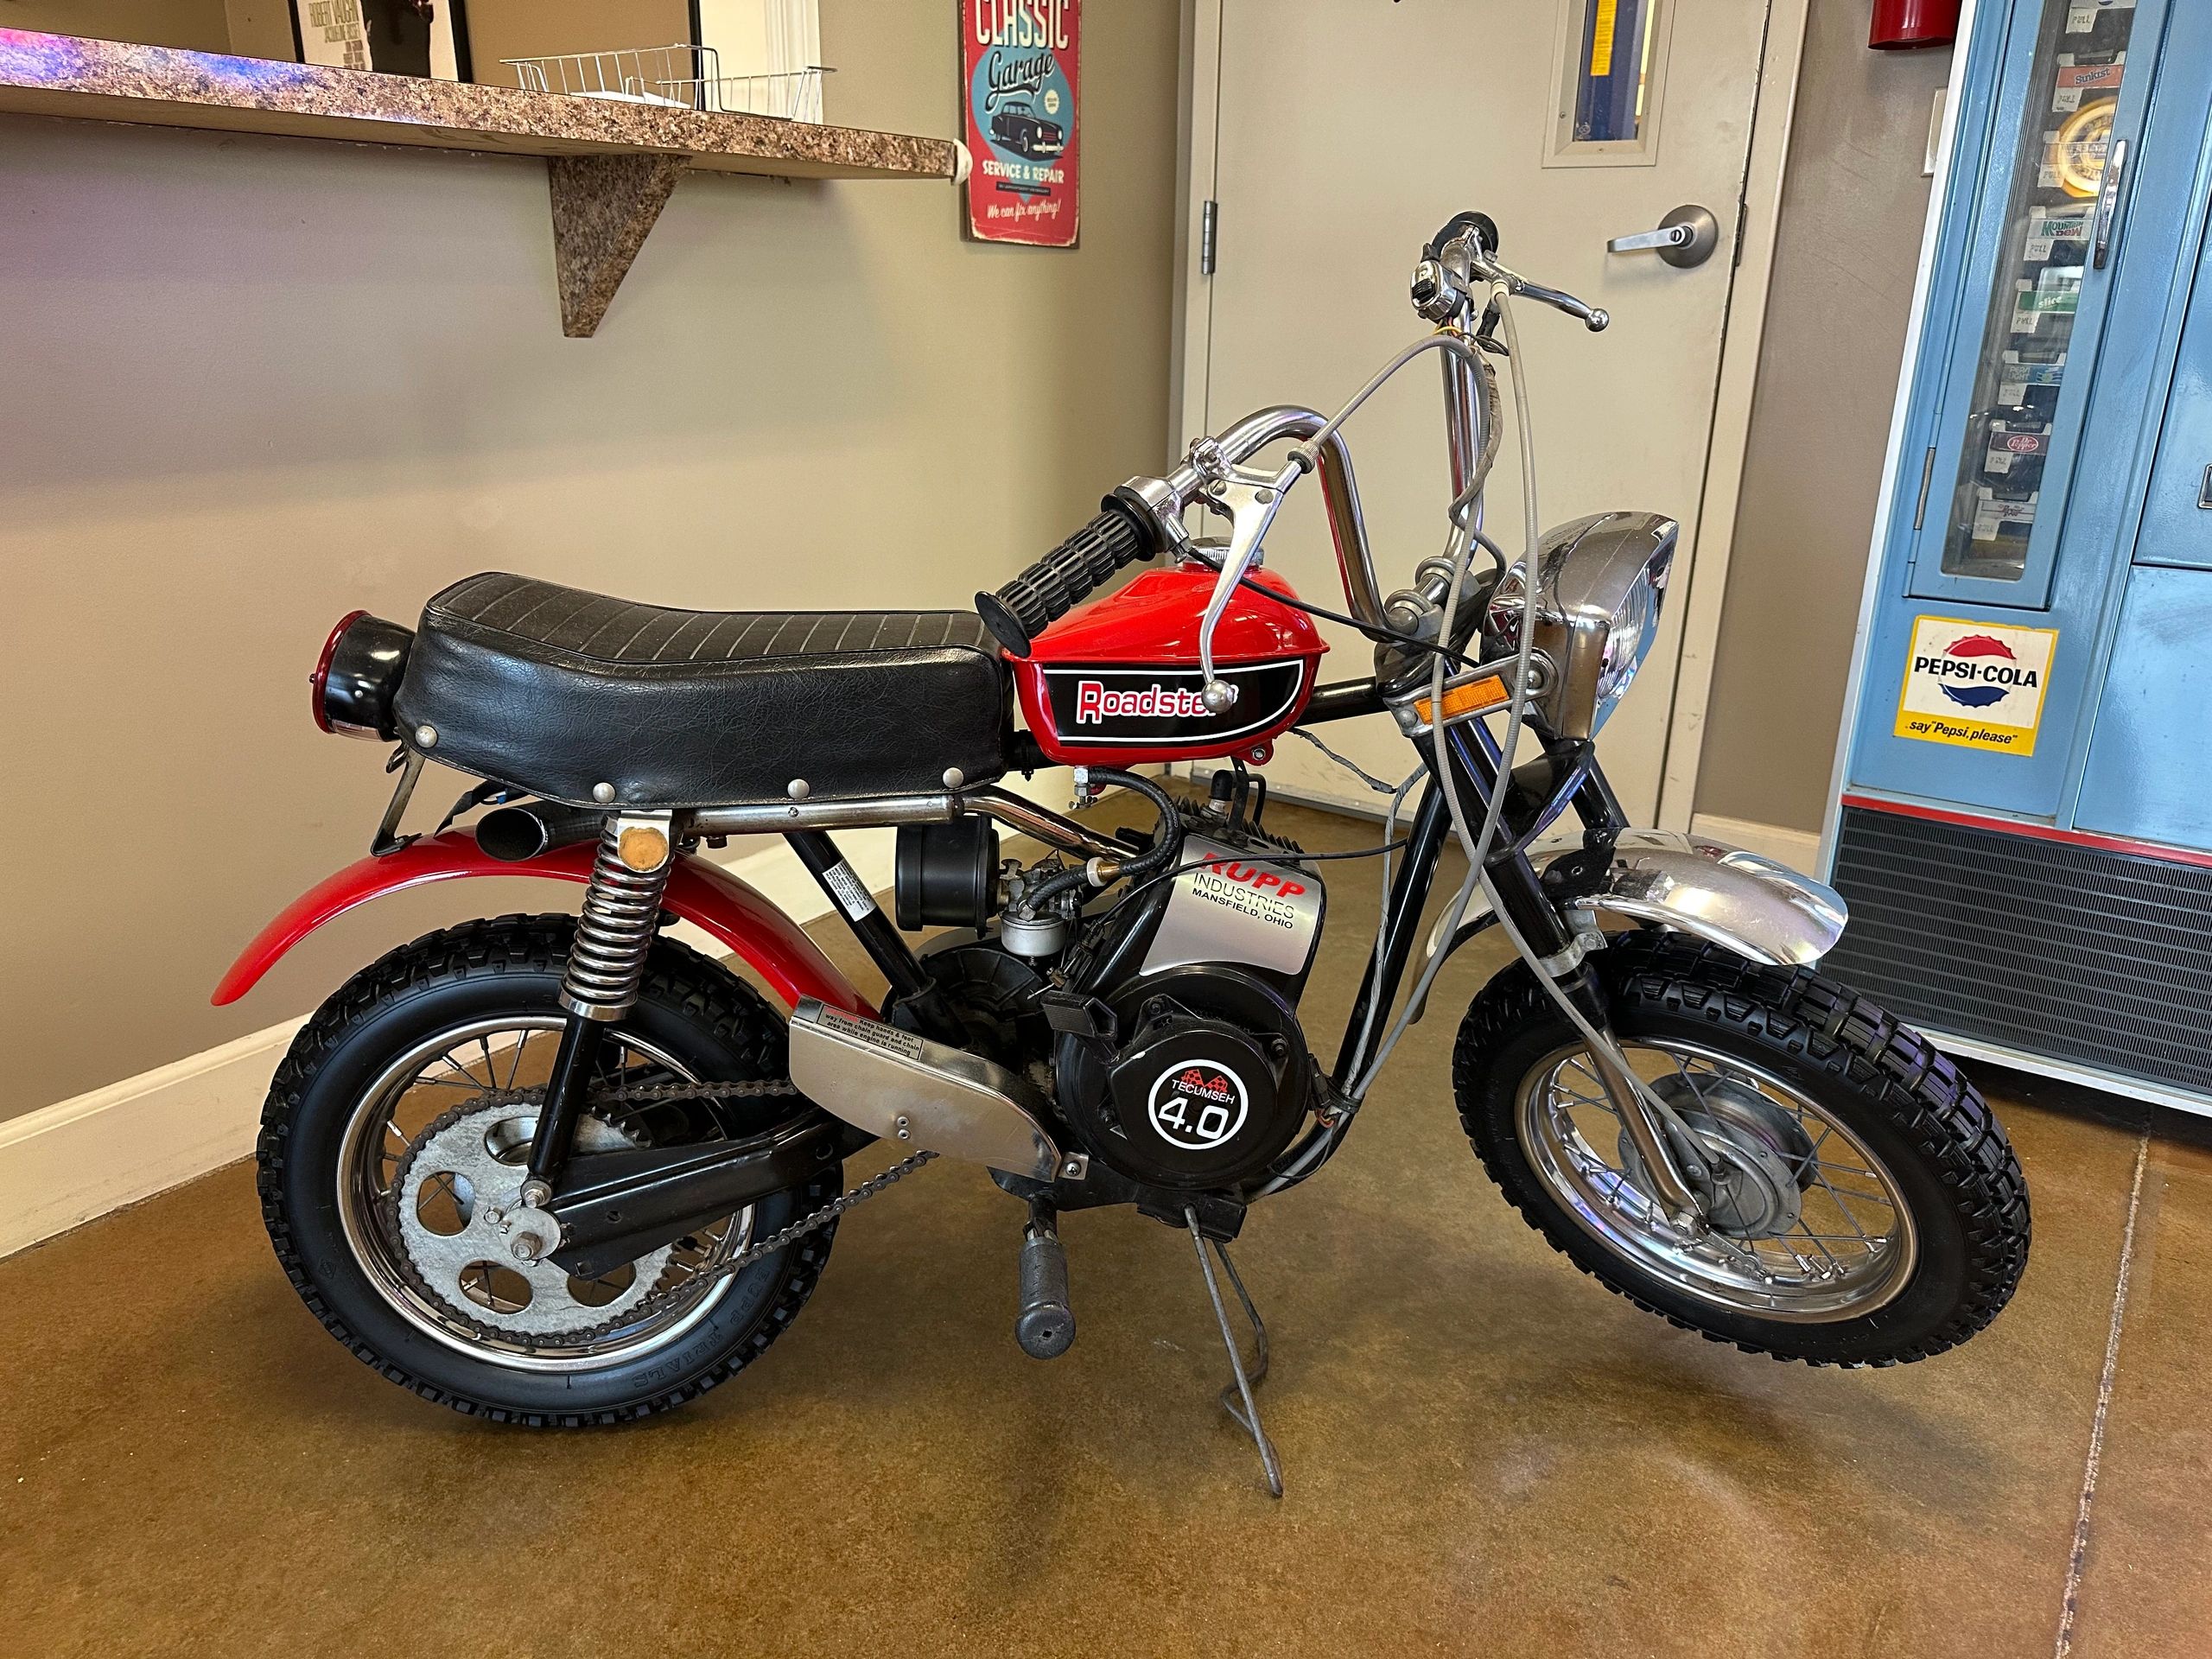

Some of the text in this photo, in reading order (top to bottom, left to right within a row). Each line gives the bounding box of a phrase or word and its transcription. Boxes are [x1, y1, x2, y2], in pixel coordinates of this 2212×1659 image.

[976, 0, 1070, 50] CLASSIC
[986, 51, 1055, 112] Garage
[2075, 67, 2111, 86] Sunkist
[982, 160, 1065, 184] SERVICE & REPAIR
[987, 197, 1062, 223] We can fix anything!
[2038, 296, 2063, 308] slice
[1076, 680, 1240, 724] Roadste
[1910, 721, 1931, 734] say
[1199, 852, 1306, 899] RUPP
[1192, 887, 1294, 930] MANSFIELD, OHIO
[1193, 872, 1295, 919] INDUSTRIES
[825, 1014, 838, 1023] way
[838, 1018, 854, 1028] from
[854, 1024, 872, 1034] chain
[872, 1029, 890, 1041] guard
[890, 1037, 903, 1046] and
[902, 1041, 920, 1052] chain
[842, 1026, 859, 1036] while
[859, 1033, 880, 1044] engine
[887, 1043, 912, 1057] running
[859, 1019, 875, 1029] Keep
[875, 1025, 894, 1036] hands
[901, 1033, 914, 1043] feet
[1172, 1078, 1236, 1104] TECUMSEH
[1158, 1096, 1230, 1140] 4.0
[632, 1328, 723, 1388] TRIALS
